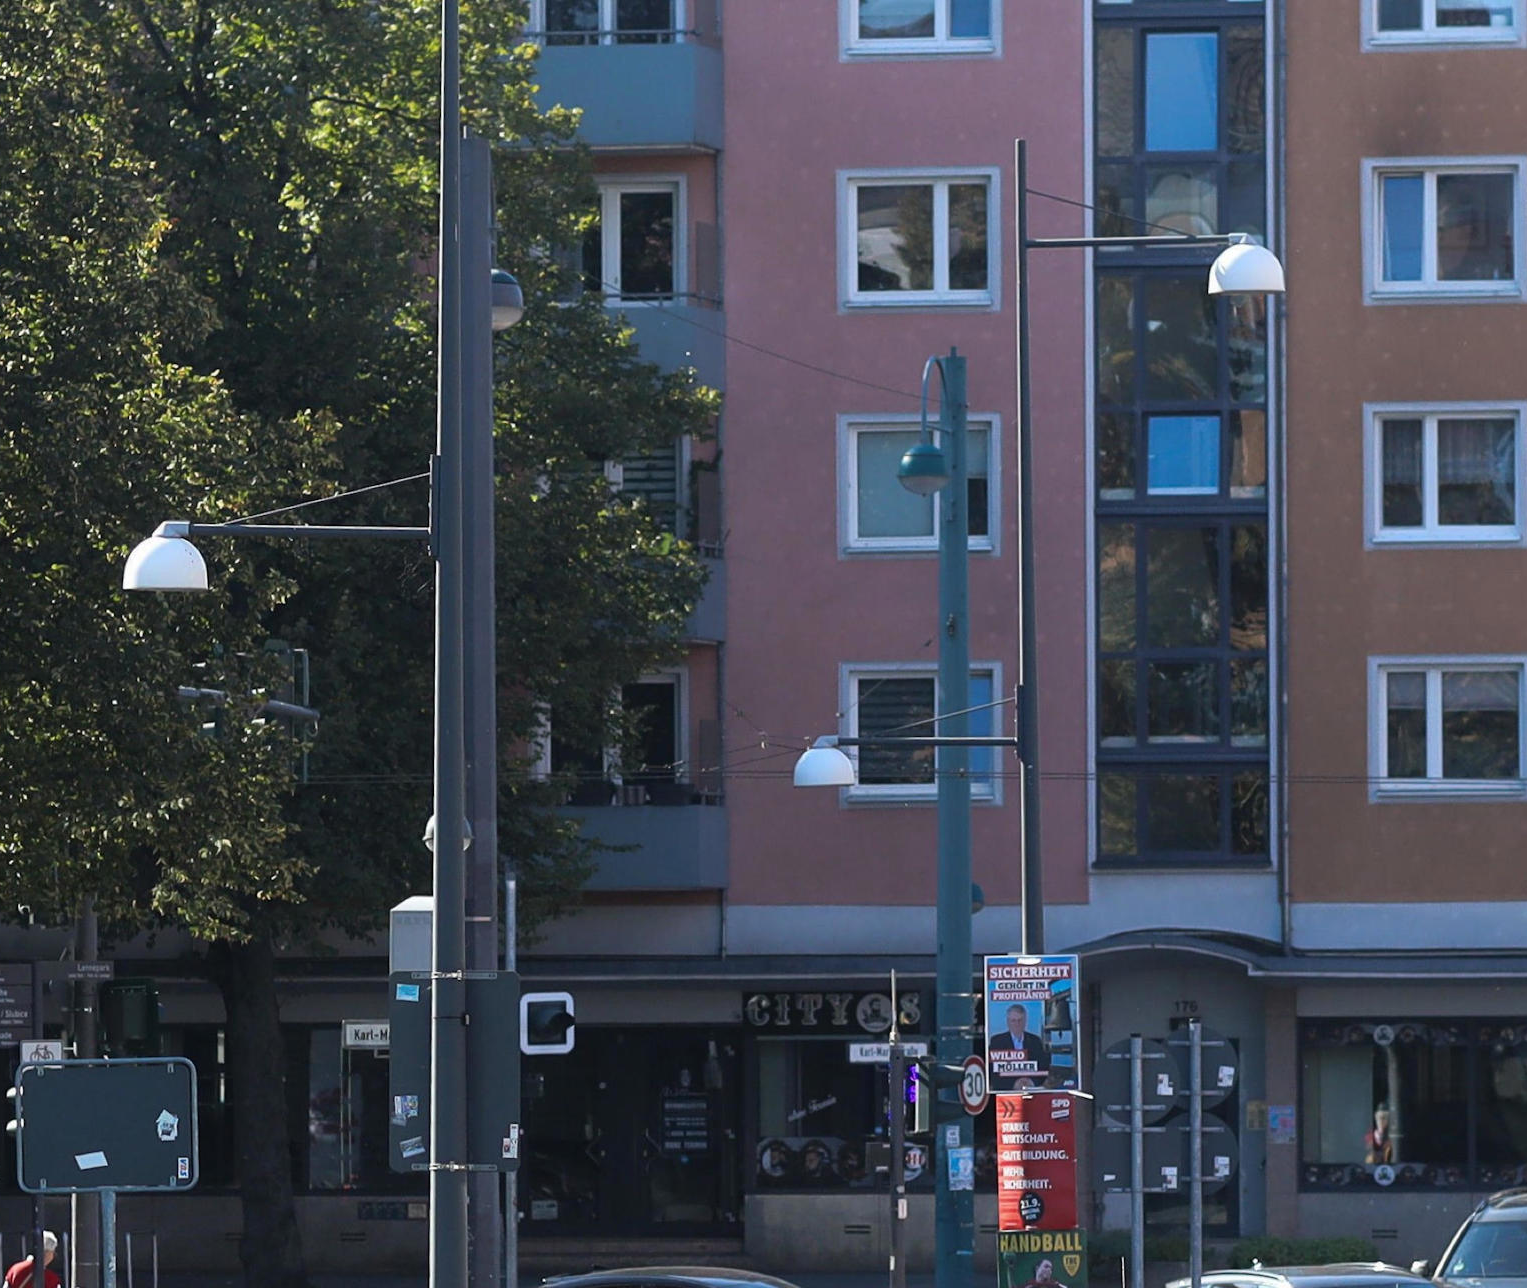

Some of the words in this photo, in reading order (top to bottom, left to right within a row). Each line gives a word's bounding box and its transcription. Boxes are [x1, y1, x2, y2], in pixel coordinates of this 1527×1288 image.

[990, 965, 1070, 979] SICHERHEIT
[998, 980, 1033, 990] GEHÖRT
[1035, 981, 1046, 989] IN
[993, 989, 1051, 1000] PROFIHÄNDE
[354, 1028, 390, 1042] Karl-M
[990, 1050, 1025, 1061] WILKO
[997, 1061, 1036, 1072] MÖLLER
[965, 1072, 983, 1098] 30
[1051, 1098, 1071, 1108] SPD
[1002, 1133, 1058, 1144] WIRTSCHAFT.
[1002, 1150, 1021, 1161] GUTE
[1022, 1149, 1069, 1160] BILDUNG.
[1003, 1179, 1053, 1190] SICHERHEIT.
[1000, 1232, 1082, 1253] HANDBALL
